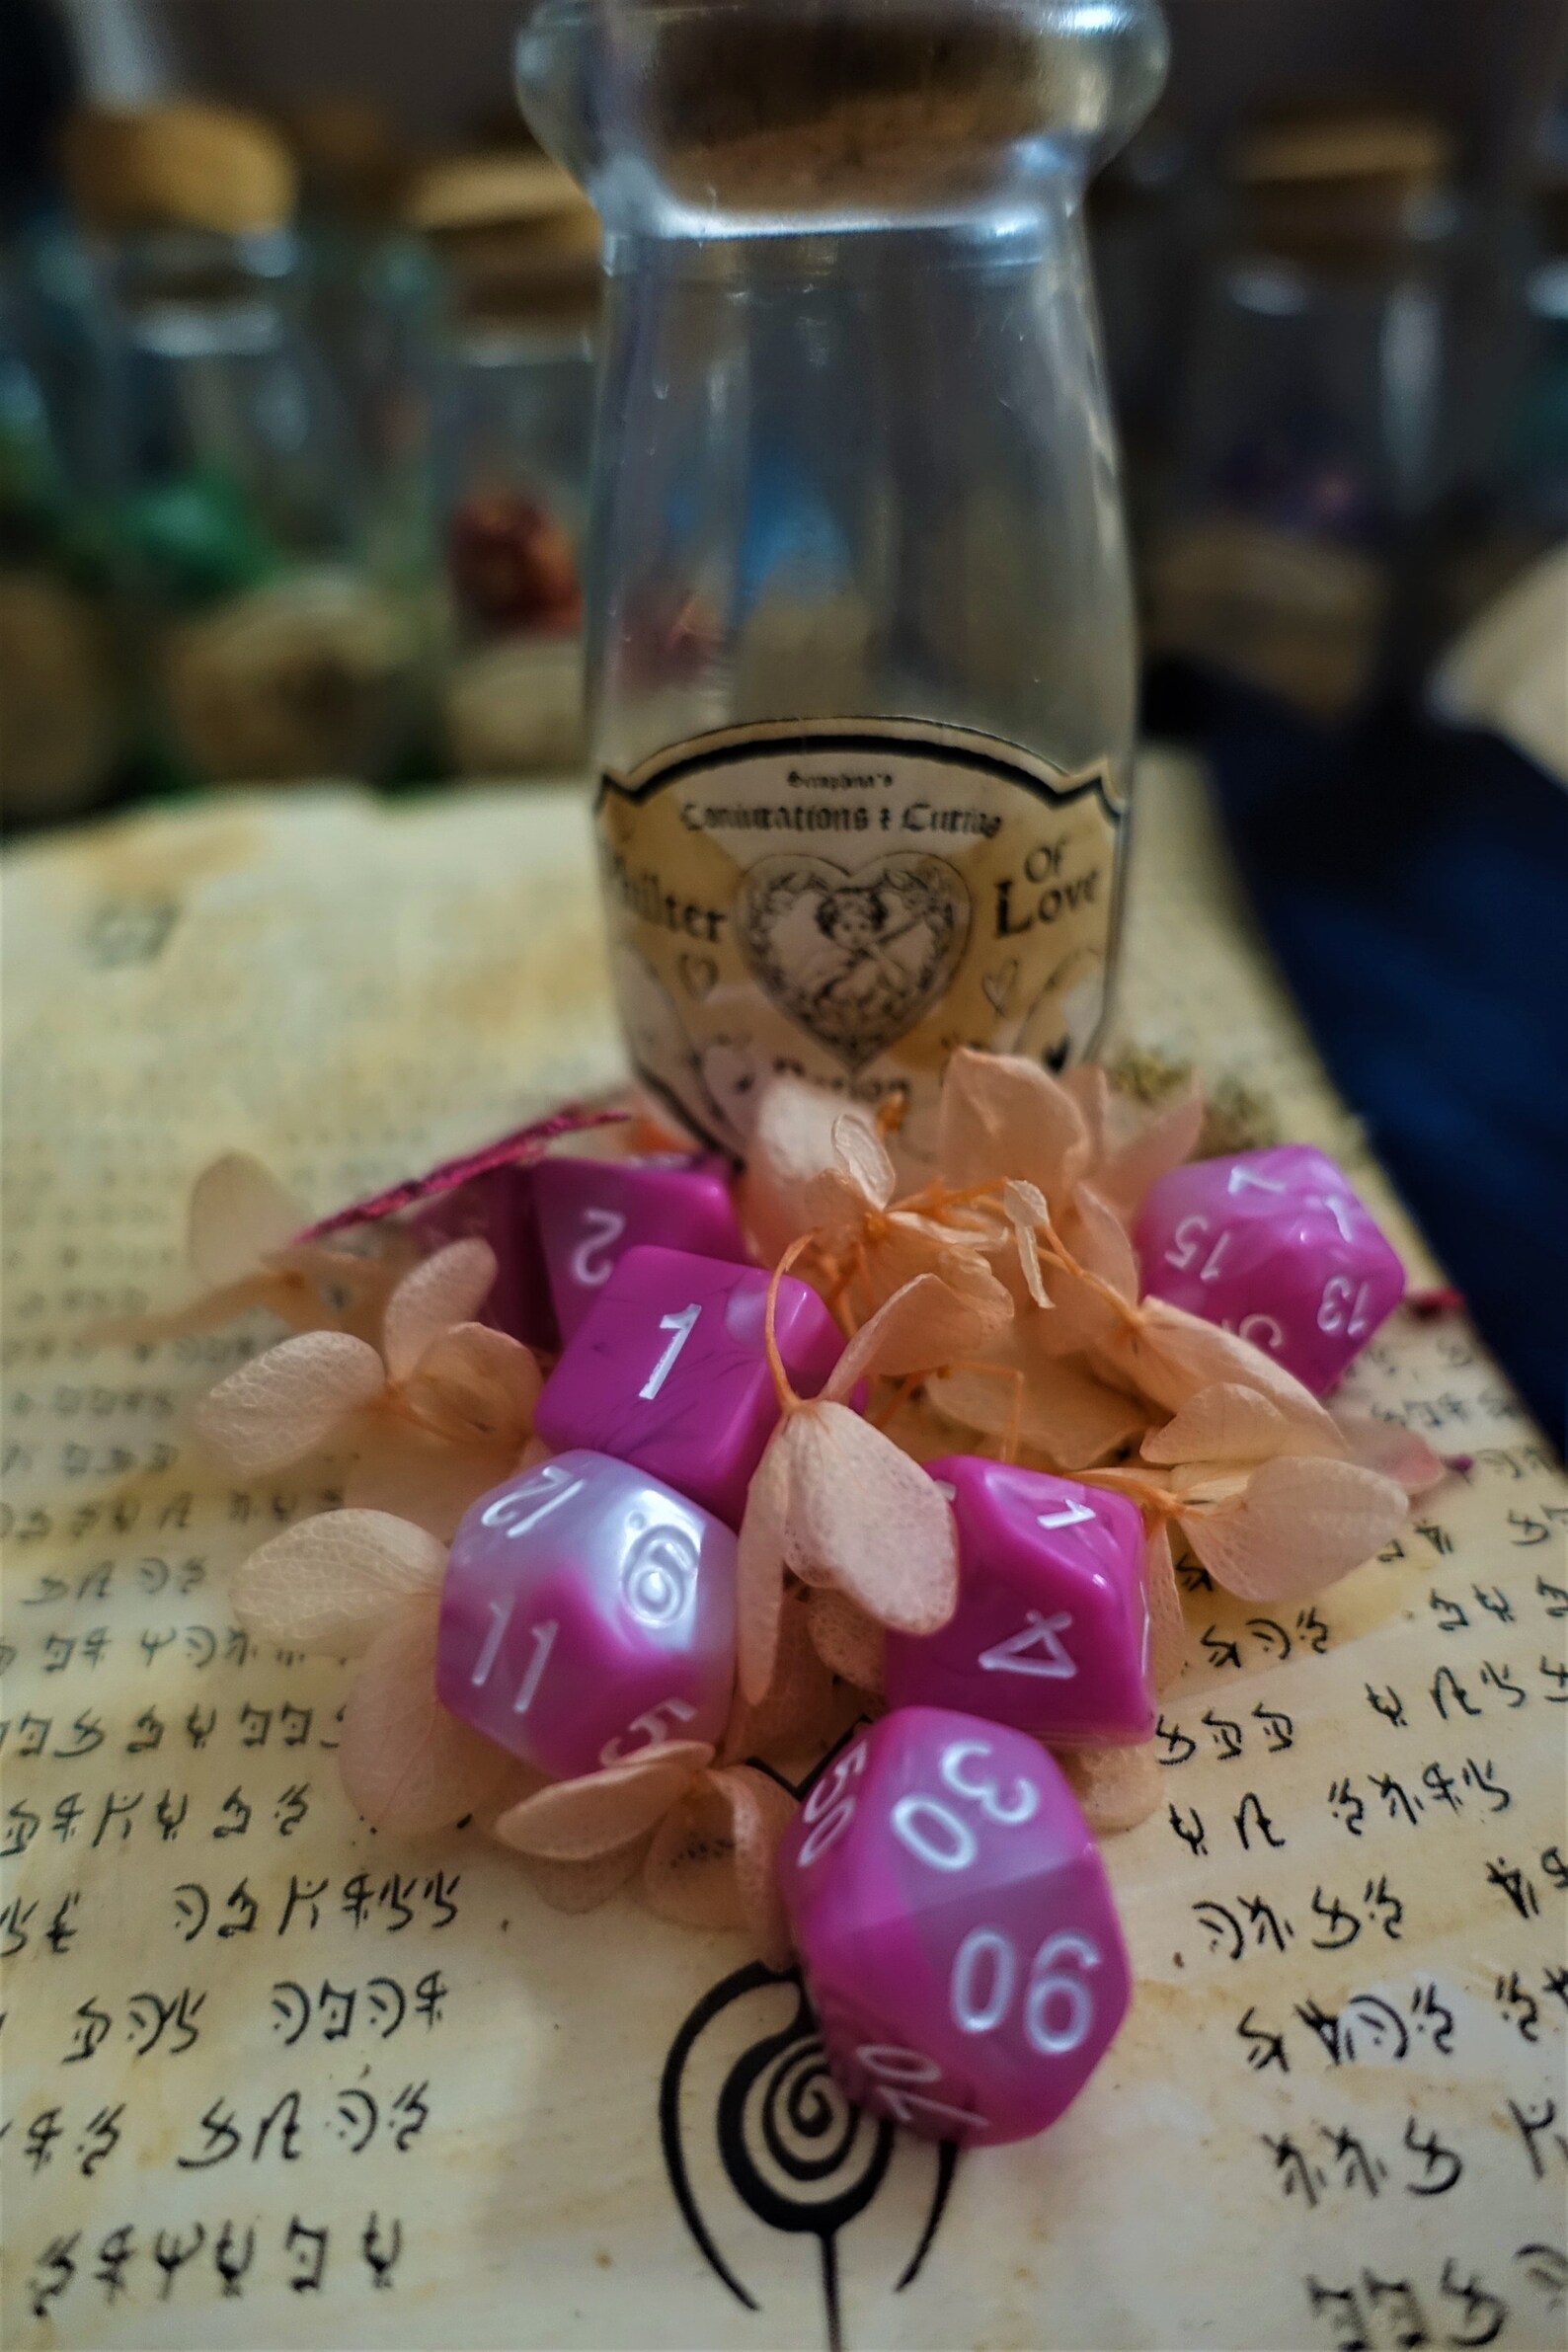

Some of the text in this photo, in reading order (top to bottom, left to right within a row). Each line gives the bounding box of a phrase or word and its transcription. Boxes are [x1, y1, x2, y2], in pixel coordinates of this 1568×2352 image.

[1024, 831, 1070, 884] Of
[993, 869, 1099, 939] Love
[1317, 1276, 1370, 1336] 13
[639, 1302, 702, 1400] 1
[1038, 1499, 1096, 1530] 1
[472, 1594, 559, 1715] 11
[978, 1609, 1077, 1679] 4
[892, 1739, 1040, 1873] 30
